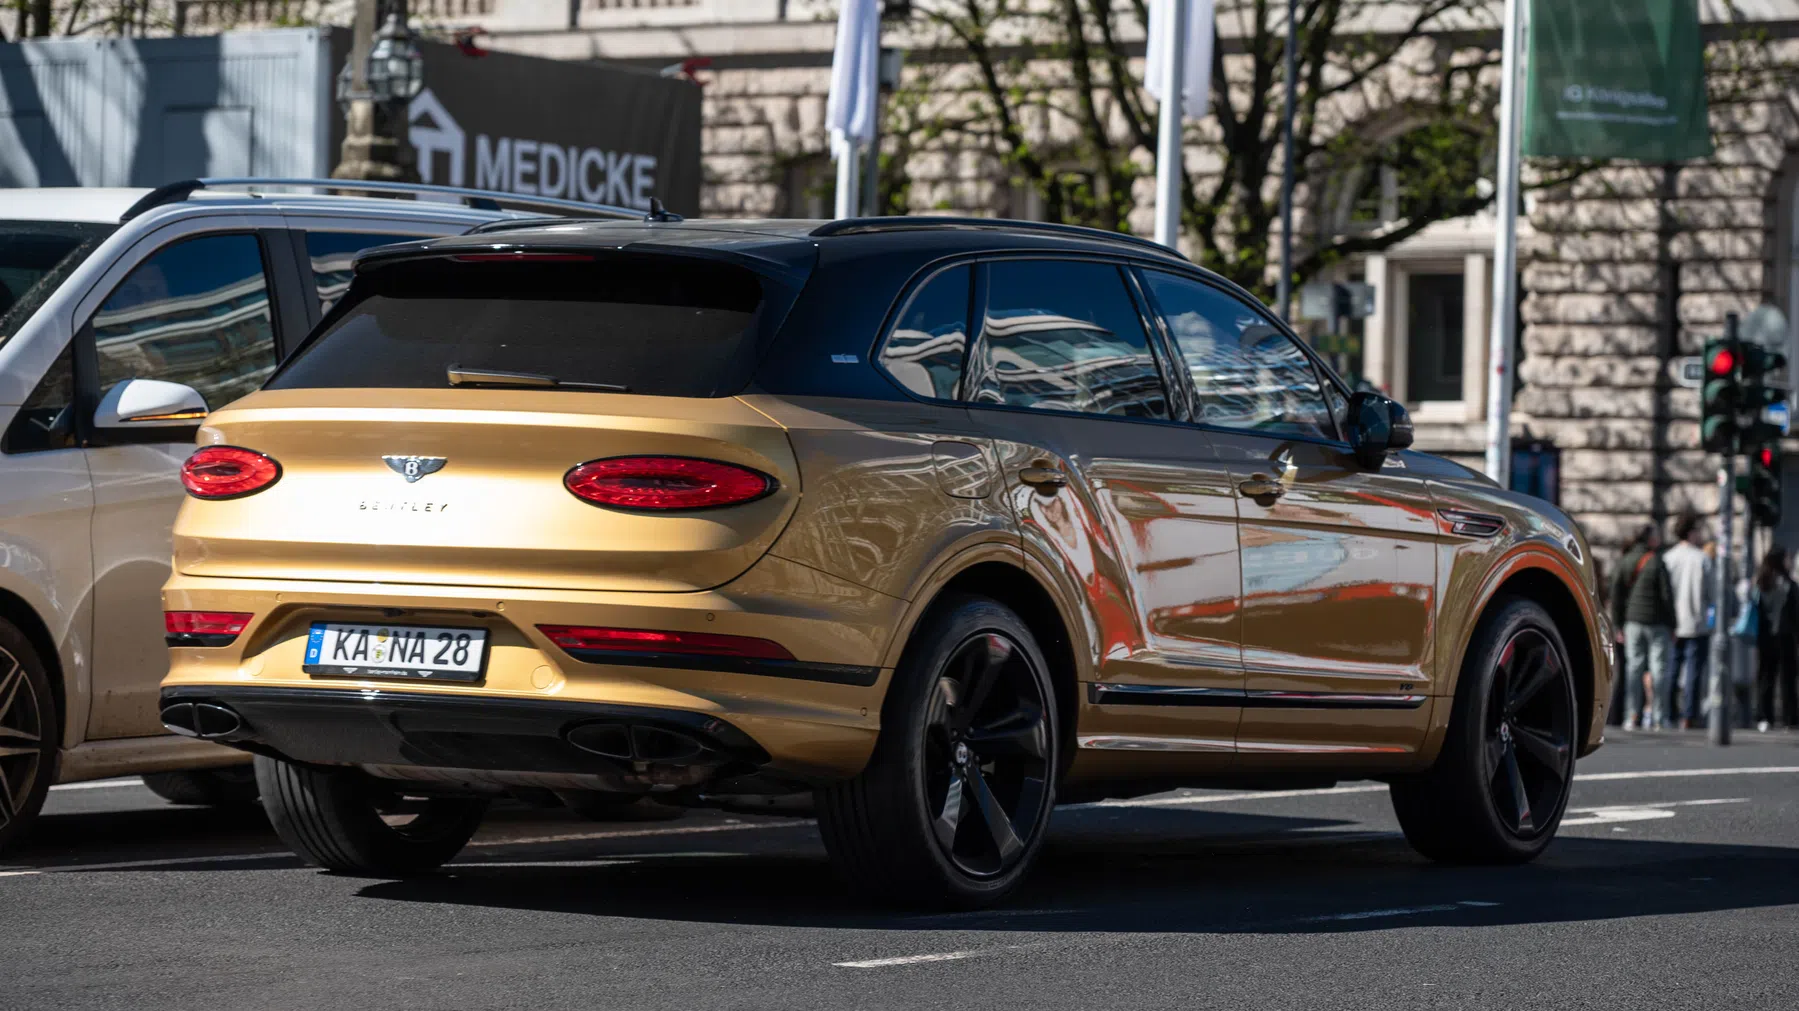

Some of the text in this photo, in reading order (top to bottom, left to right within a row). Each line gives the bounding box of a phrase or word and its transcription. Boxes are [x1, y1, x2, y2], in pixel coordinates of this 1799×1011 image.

[475, 133, 657, 208] MEDICKE
[404, 461, 419, 476] B
[333, 629, 471, 666] KA NA 28
